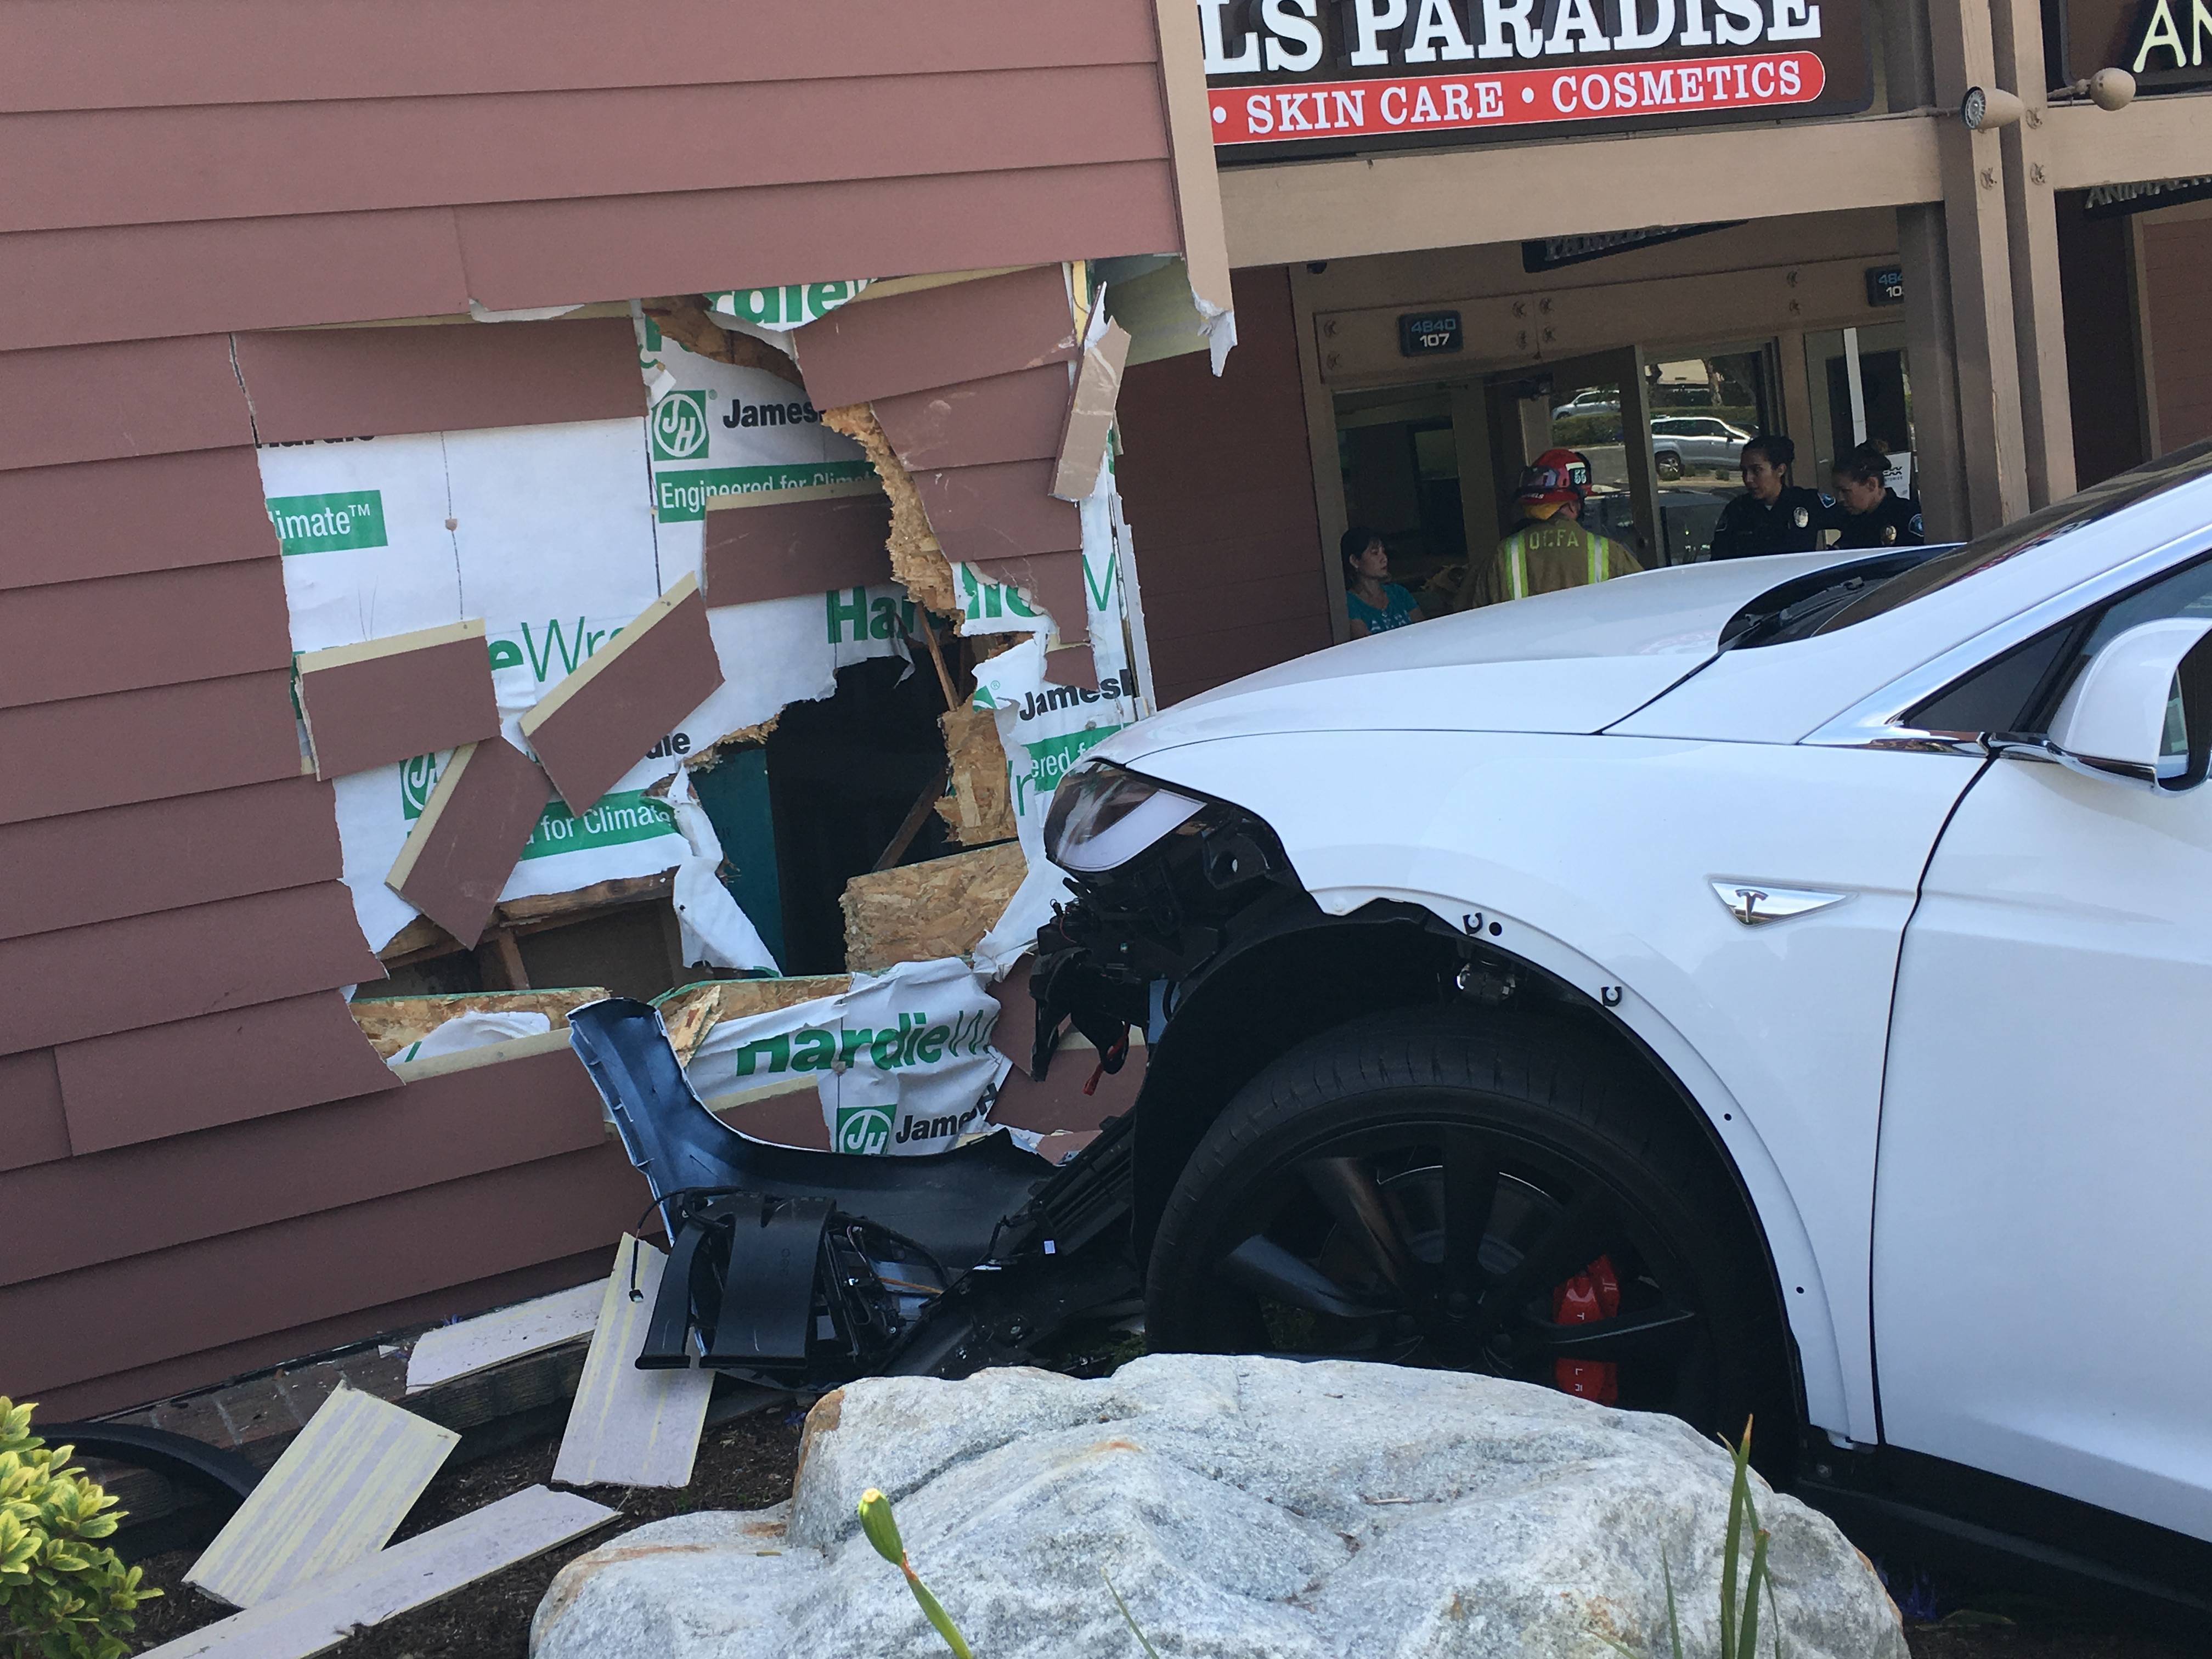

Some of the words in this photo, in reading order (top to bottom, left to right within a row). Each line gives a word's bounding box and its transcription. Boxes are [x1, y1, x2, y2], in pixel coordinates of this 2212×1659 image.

[1198, 0, 1323, 74] LS
[1351, 0, 1821, 66] PARADISE
[1246, 89, 1365, 134] SKIN
[1380, 81, 1504, 126] CARE
[1551, 60, 1802, 113] COSMETICS
[1411, 319, 1456, 333] 4840
[1420, 333, 1450, 347] 107
[723, 399, 825, 428] James
[1530, 529, 1579, 550] OCFA
[540, 815, 574, 840] for
